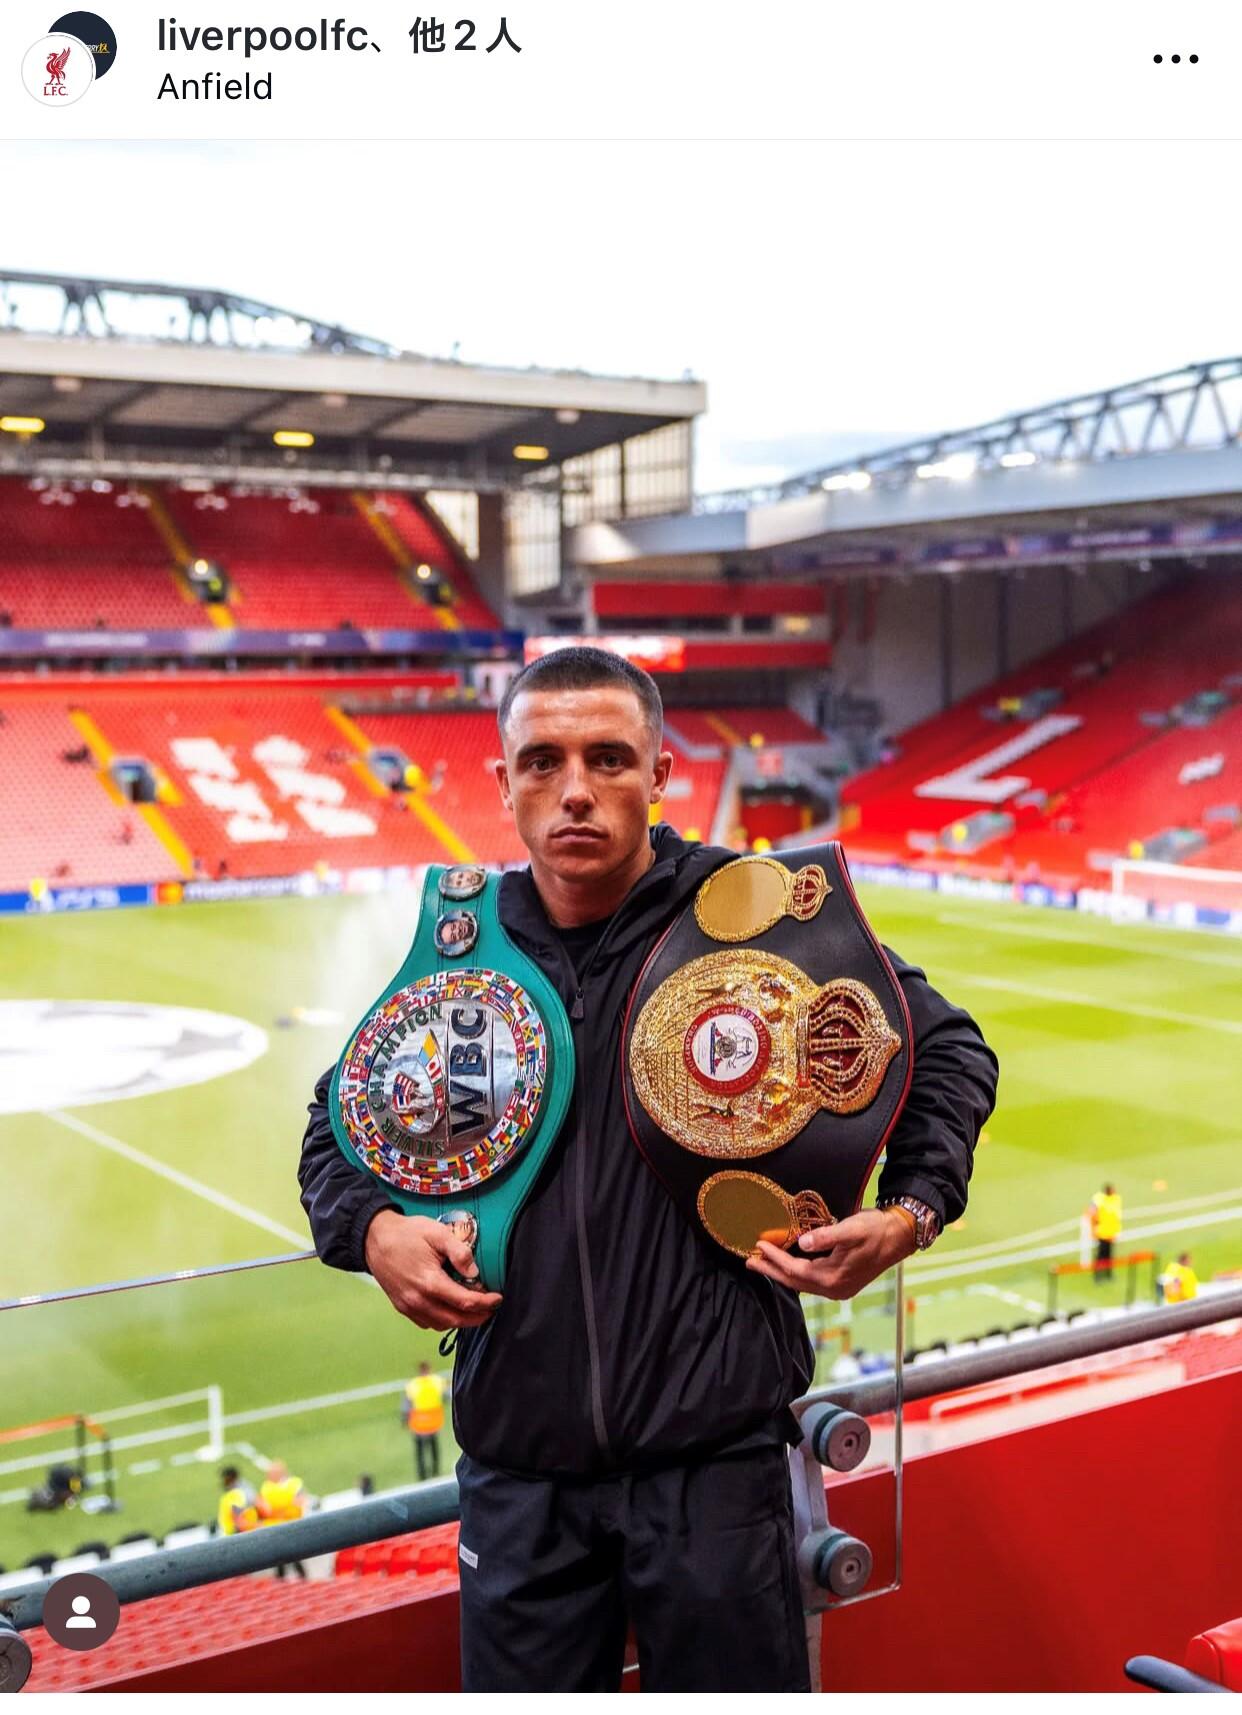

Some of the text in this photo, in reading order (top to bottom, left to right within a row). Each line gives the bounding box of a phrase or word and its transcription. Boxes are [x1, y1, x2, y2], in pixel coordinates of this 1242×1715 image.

[369, 1003, 446, 1157] SILVER CHAMPION
[448, 1007, 488, 1138] WBC
